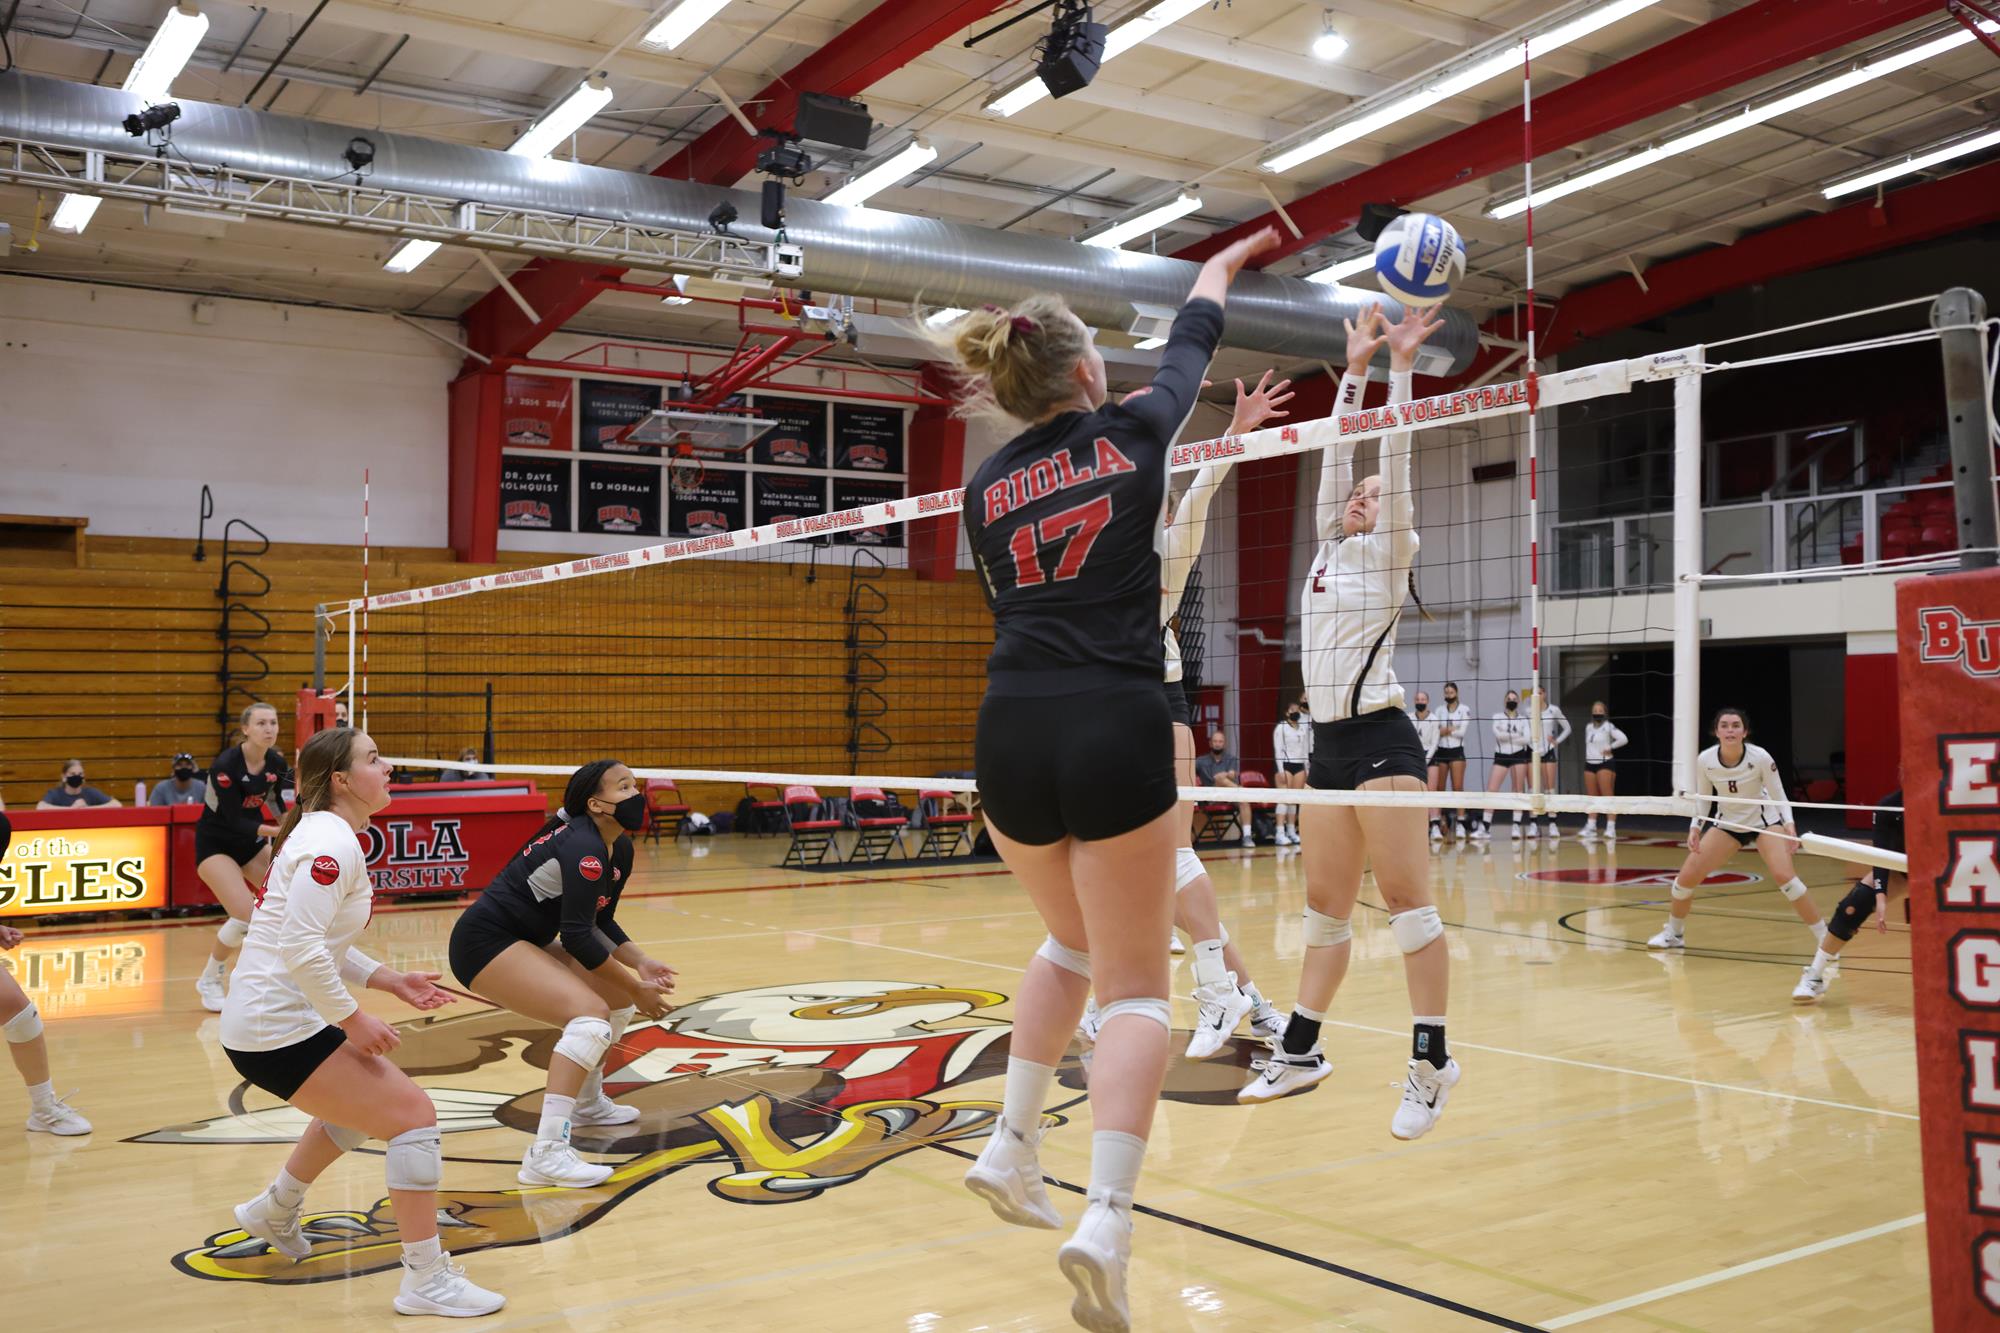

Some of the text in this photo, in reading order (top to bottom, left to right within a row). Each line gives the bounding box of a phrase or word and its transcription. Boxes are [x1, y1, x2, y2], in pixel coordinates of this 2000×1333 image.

[1343, 382, 1357, 405] APU
[1340, 406, 1397, 435] BIOLA
[1400, 379, 1529, 424] VOLLEYBAL
[1280, 427, 1298, 445] BU
[1171, 436, 1245, 466] LEYBALL
[505, 471, 552, 482] DR. DAVE
[590, 482, 650, 493] ED NORMAN
[982, 436, 1137, 528] BIOLA
[505, 500, 552, 520] BIOLA
[917, 491, 950, 513] BIOLA
[597, 505, 642, 525] BIOLA
[776, 519, 802, 538] BIOLA
[803, 508, 865, 534] VOLLEYBALL
[686, 533, 735, 556] VOLLEYBALL
[1008, 494, 1113, 588] 17
[1918, 605, 2000, 678] BU
[1727, 780, 1738, 794] 8
[17, 838, 87, 857] of the
[356, 819, 469, 866] OLA
[367, 865, 469, 891] RSITY
